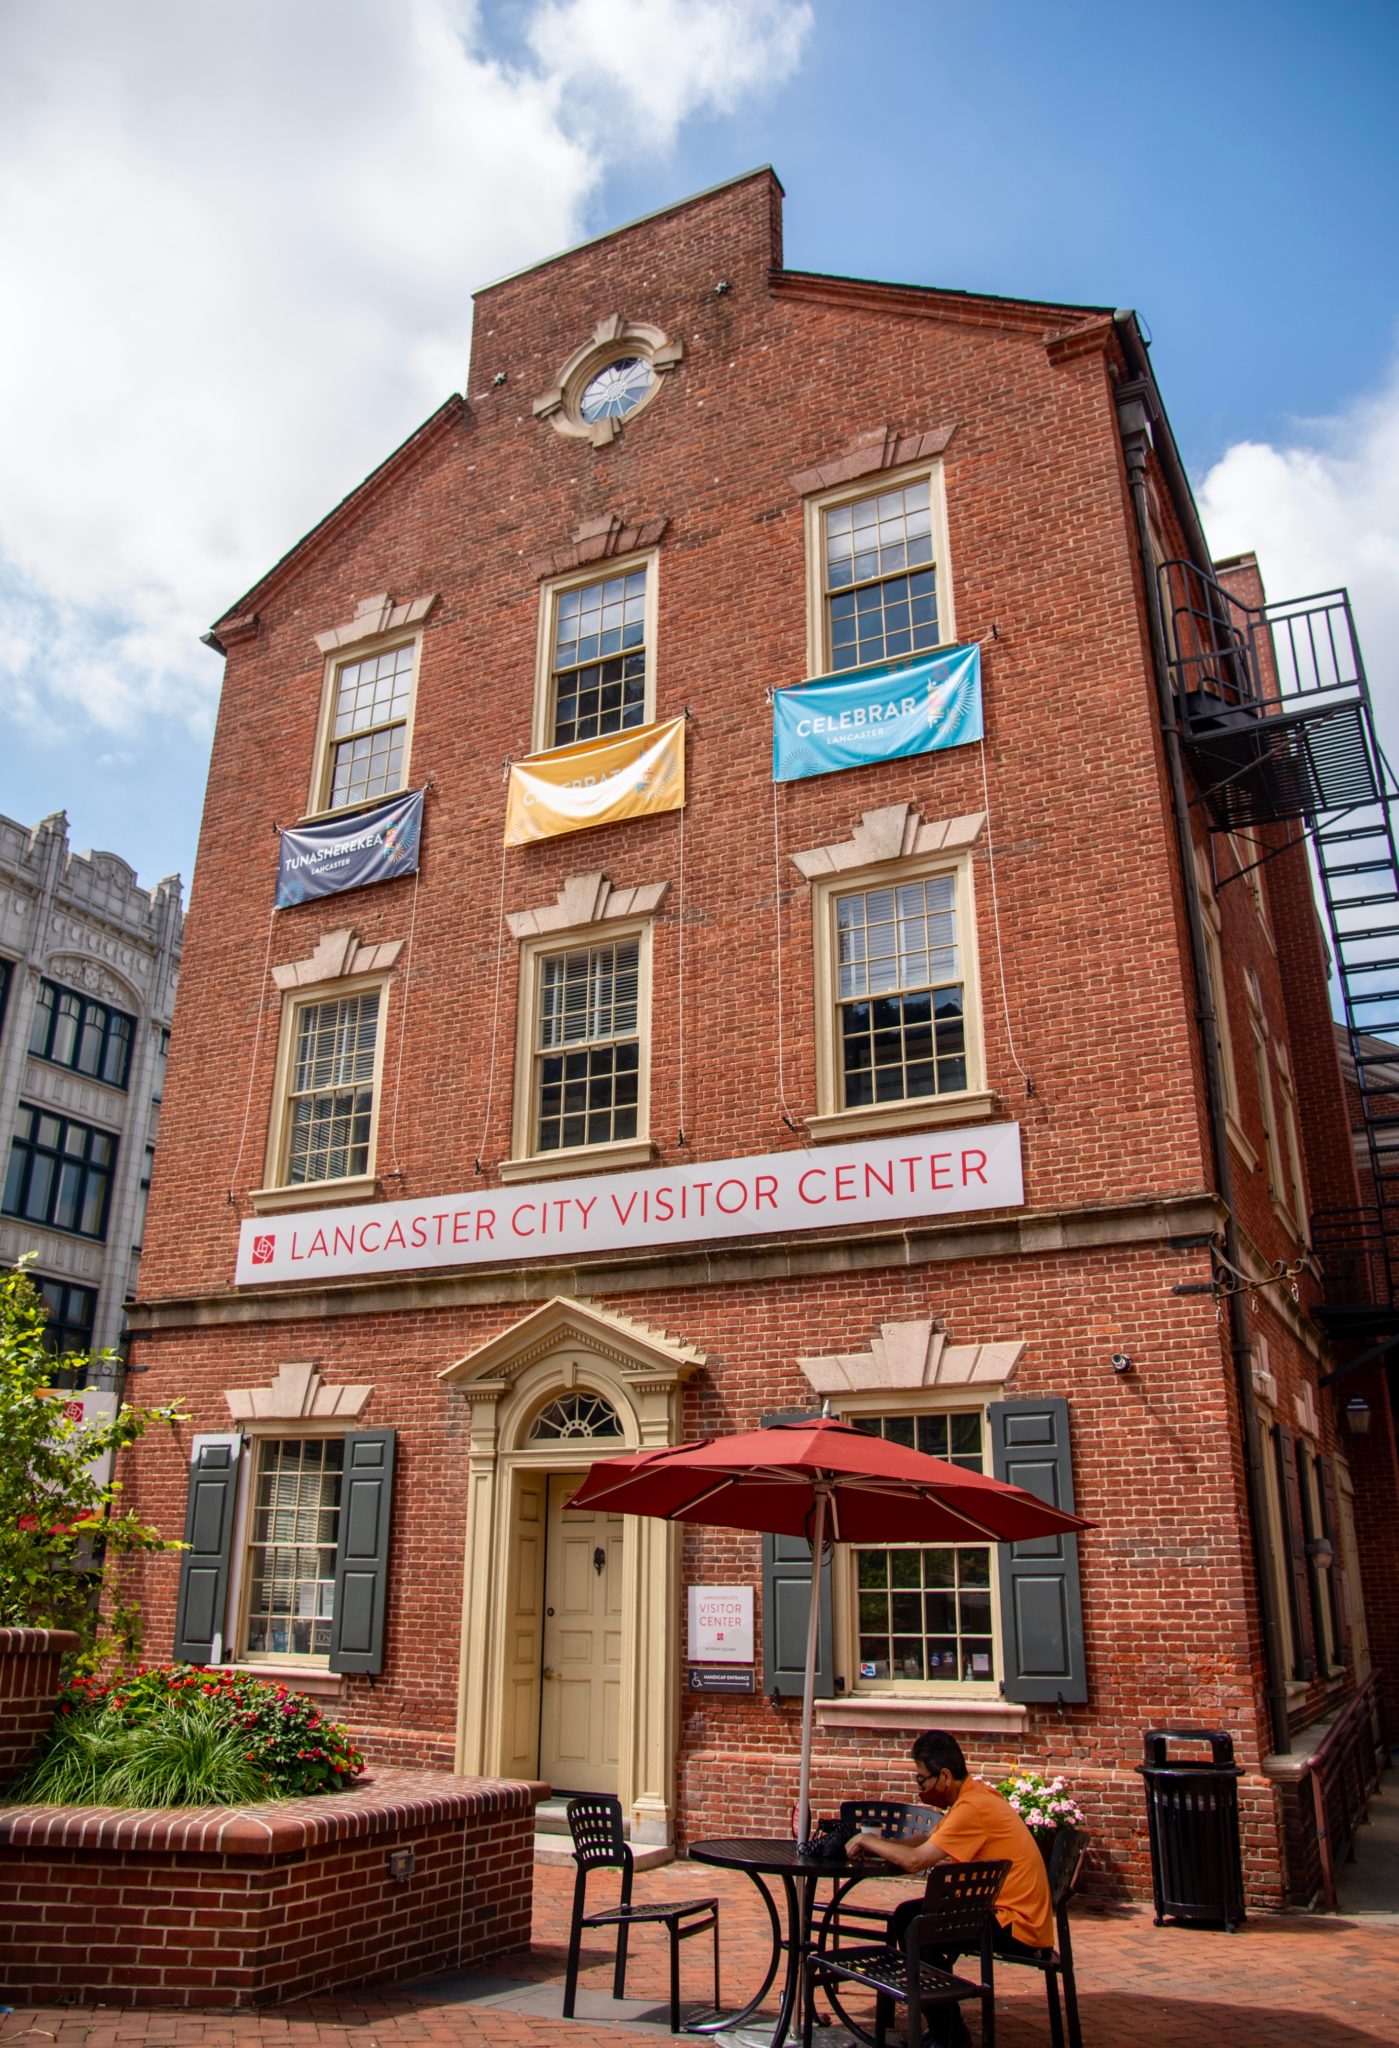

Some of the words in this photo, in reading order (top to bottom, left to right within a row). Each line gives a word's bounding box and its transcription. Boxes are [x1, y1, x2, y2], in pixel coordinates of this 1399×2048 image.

[797, 697, 916, 737] CELEBRAR
[827, 728, 884, 745] LANCASTER
[285, 833, 384, 872] TUNASHEREKEA
[311, 858, 351, 875] LANCASTER
[291, 1209, 496, 1261] LANCASTER
[512, 1196, 598, 1237] CITY
[611, 1175, 779, 1226] VISITOR
[798, 1149, 989, 1205] CENTER
[699, 1603, 742, 1614] VISITOR
[699, 1616, 742, 1627] CENTER
